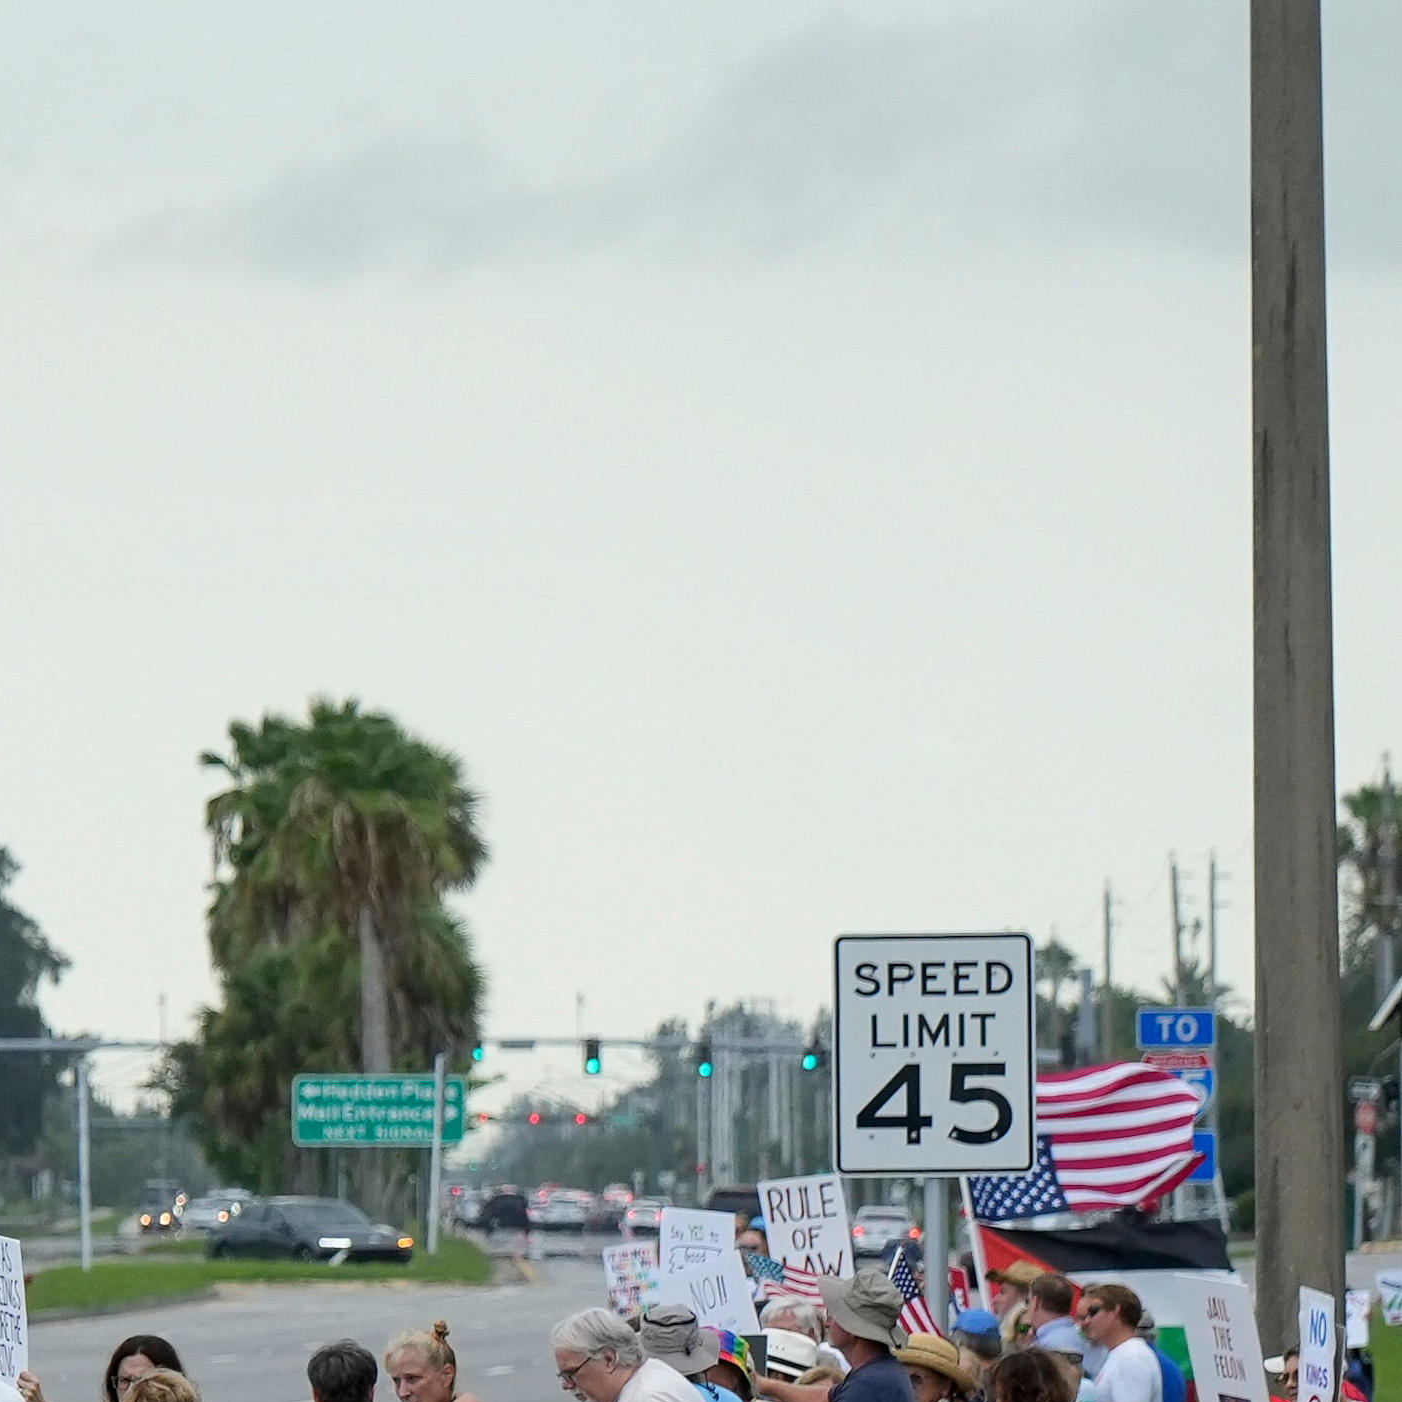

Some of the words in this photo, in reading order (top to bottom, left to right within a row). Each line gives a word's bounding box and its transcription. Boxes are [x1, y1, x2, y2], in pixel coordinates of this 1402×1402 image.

[854, 961, 1013, 997] SPEED
[871, 1013, 996, 1048] LIMIT
[1155, 1015, 1198, 1043] TO
[856, 1062, 1013, 1145] 45
[767, 1182, 838, 1224] RULE
[792, 1225, 823, 1251] OF
[1207, 1296, 1231, 1323] JAIL
[1212, 1326, 1234, 1352] THE
[1309, 1309, 1327, 1348] NO
[1214, 1354, 1246, 1382] FELON
[1305, 1363, 1328, 1389] KINGS
